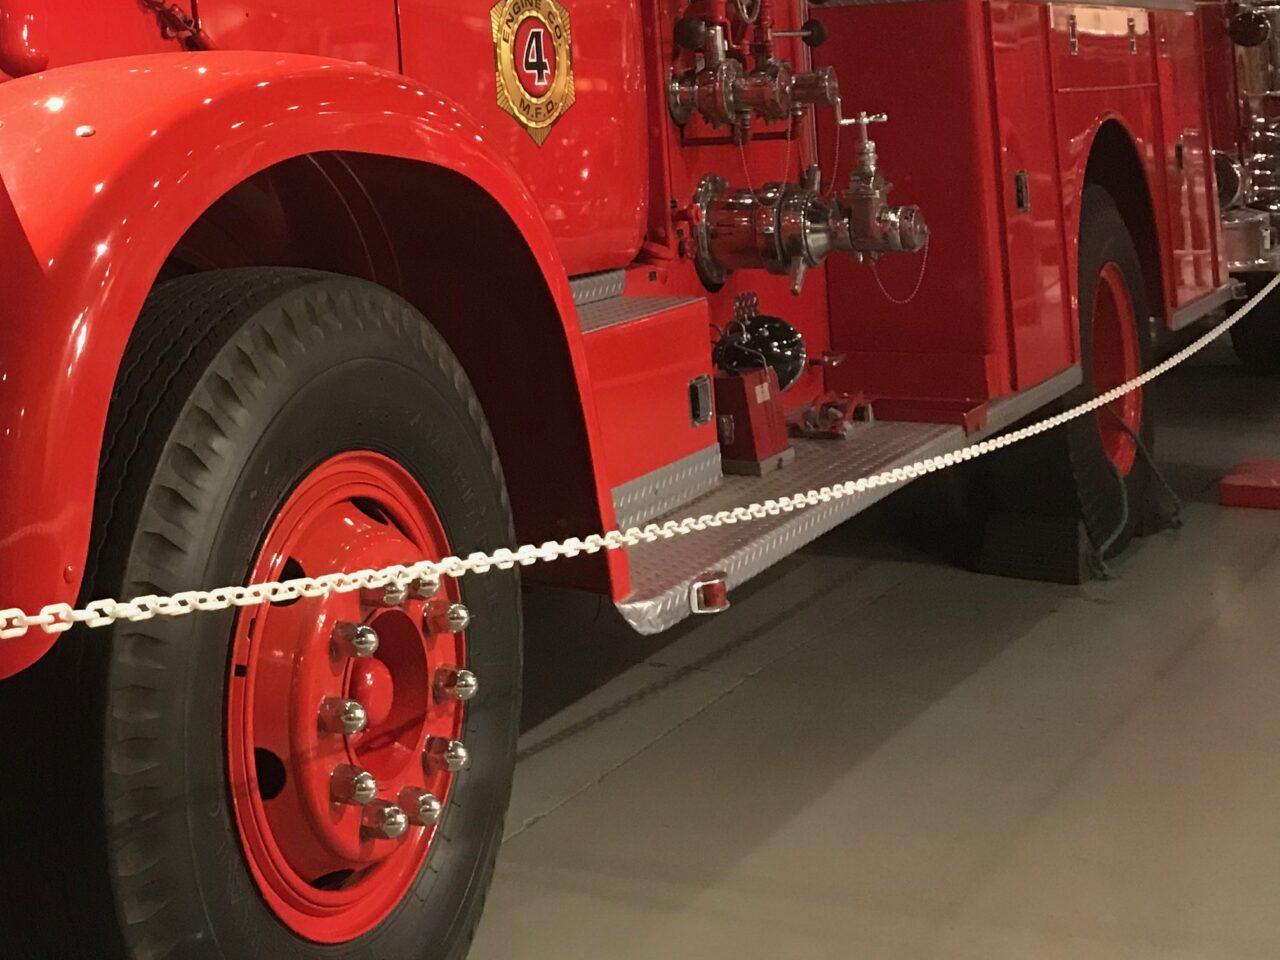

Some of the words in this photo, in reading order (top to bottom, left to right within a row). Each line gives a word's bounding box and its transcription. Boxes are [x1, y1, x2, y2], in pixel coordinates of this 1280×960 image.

[547, 10, 563, 48] CO.
[523, 28, 550, 86] 4
[519, 97, 558, 119] M.F.D.
